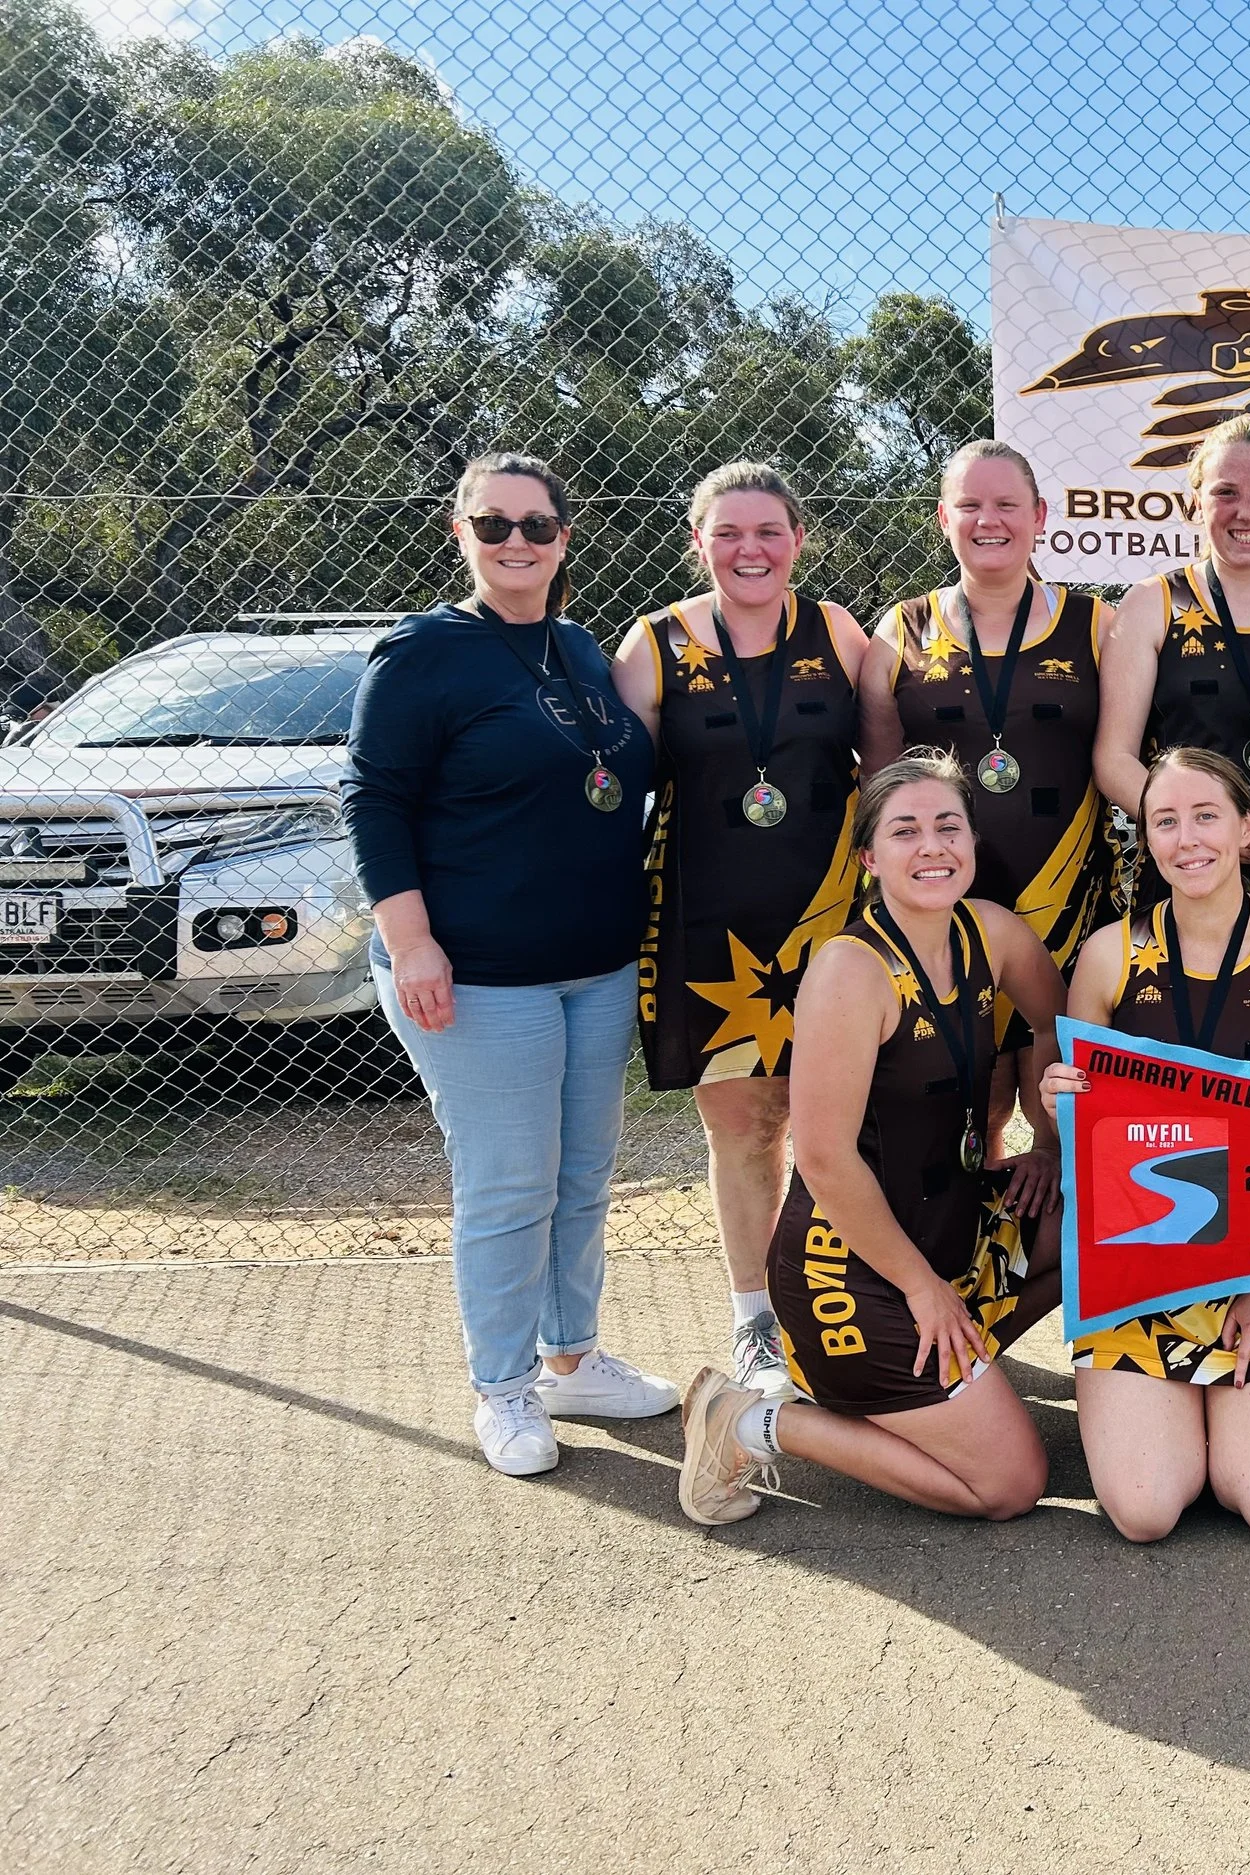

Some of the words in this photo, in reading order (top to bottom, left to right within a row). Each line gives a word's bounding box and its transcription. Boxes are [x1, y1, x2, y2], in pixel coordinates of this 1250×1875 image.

[913, 1026, 935, 1038] PDR
[1088, 1049, 1194, 1093] MURRAY
[1127, 1123, 1194, 1142] MVFNL
[803, 1203, 868, 1357] BOMB
